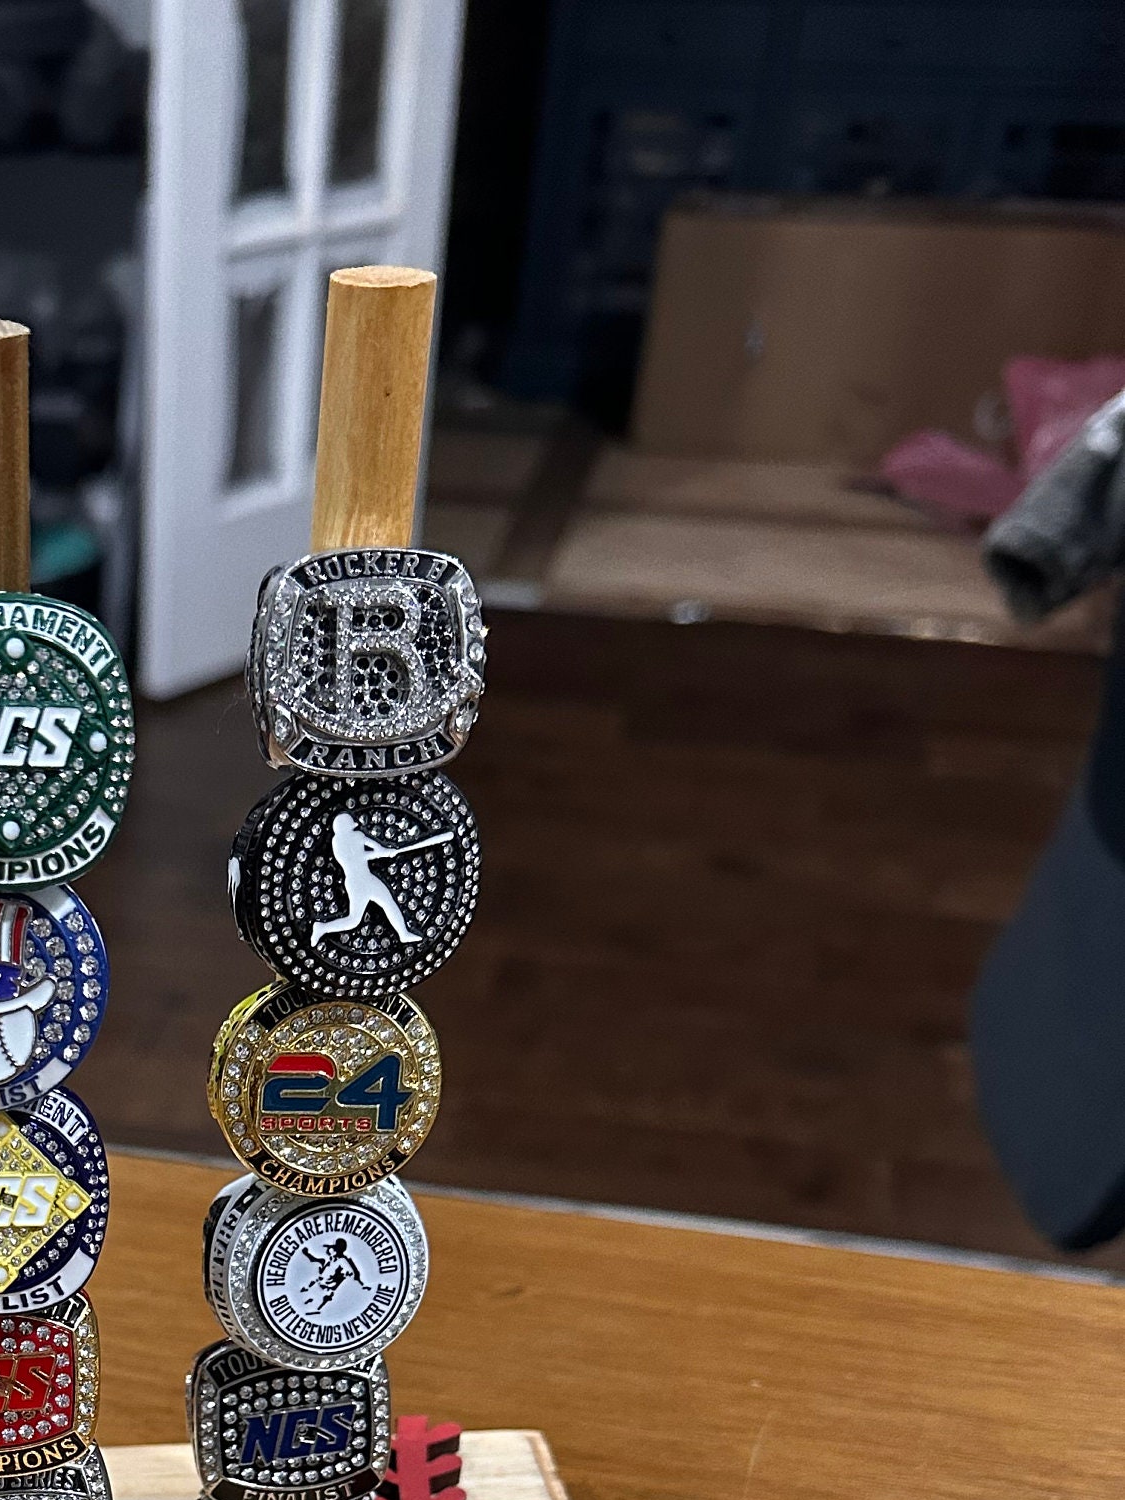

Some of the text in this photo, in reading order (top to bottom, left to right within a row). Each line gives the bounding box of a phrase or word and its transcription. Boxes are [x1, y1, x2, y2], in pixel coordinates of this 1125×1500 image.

[425, 557, 449, 582] B
[305, 736, 445, 771] RANCH
[260, 1052, 414, 1132] 24
[259, 1116, 373, 1133] SPORTS
[260, 1156, 396, 1194] CHAMPIONS
[266, 1212, 398, 1287] HEROES ARE REMEMBERED
[269, 1283, 397, 1344] BUT LEGENDS NEVER DIE
[239, 1402, 358, 1467] NCS
[10, 1467, 75, 1489] SERIES
